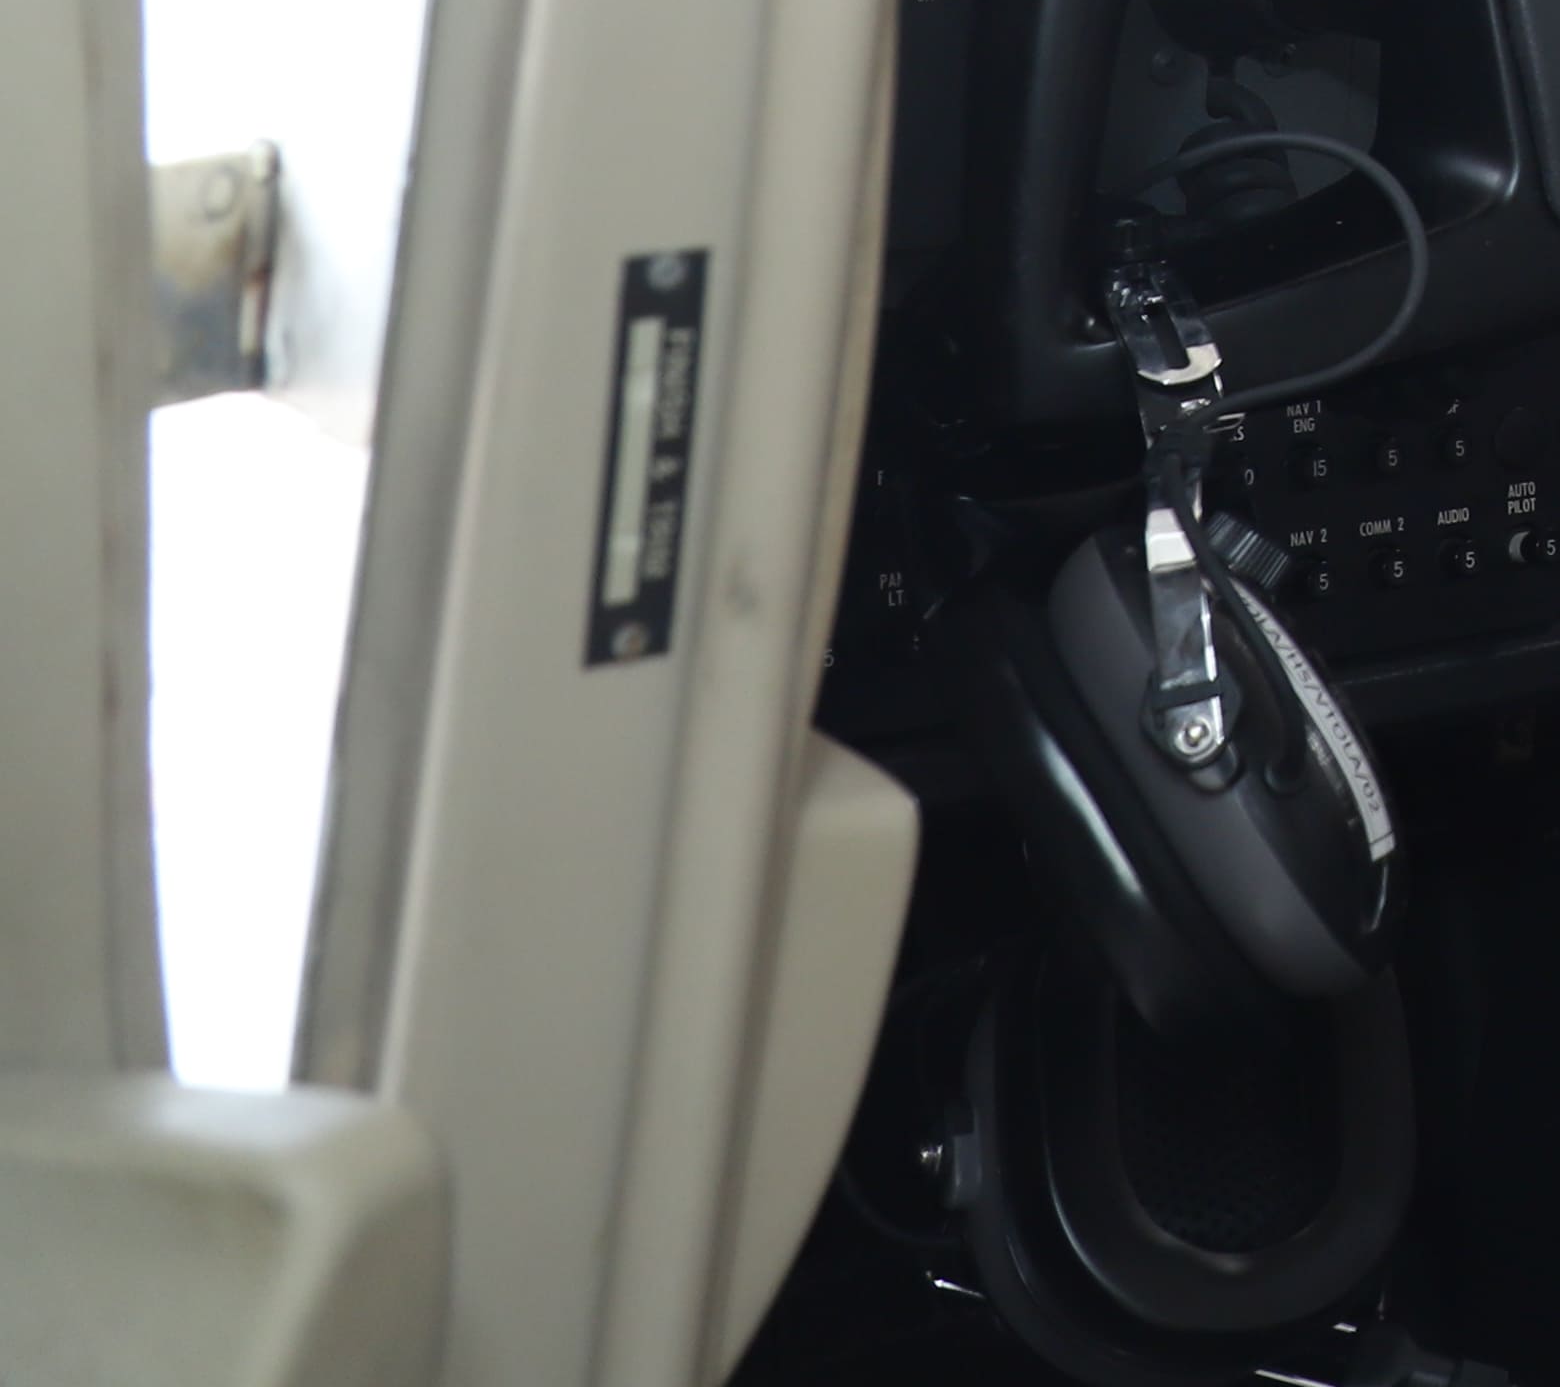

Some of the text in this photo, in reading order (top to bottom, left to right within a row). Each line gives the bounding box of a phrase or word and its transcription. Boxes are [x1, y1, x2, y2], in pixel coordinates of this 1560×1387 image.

[1293, 417, 1316, 434] ENG
[1388, 449, 1398, 468] 5
[1455, 440, 1465, 458] 5
[1312, 459, 1327, 478] 15
[1507, 480, 1537, 499] AUTO
[1507, 497, 1538, 516] PILOT
[1437, 507, 1471, 526] AUDIO
[1357, 517, 1406, 538] COMM 2
[1290, 528, 1329, 548] NAV 2
[1545, 538, 1557, 556] 5
[1463, 550, 1476, 569] 5
[1392, 560, 1405, 580] 5
[1318, 573, 1330, 590] 5
